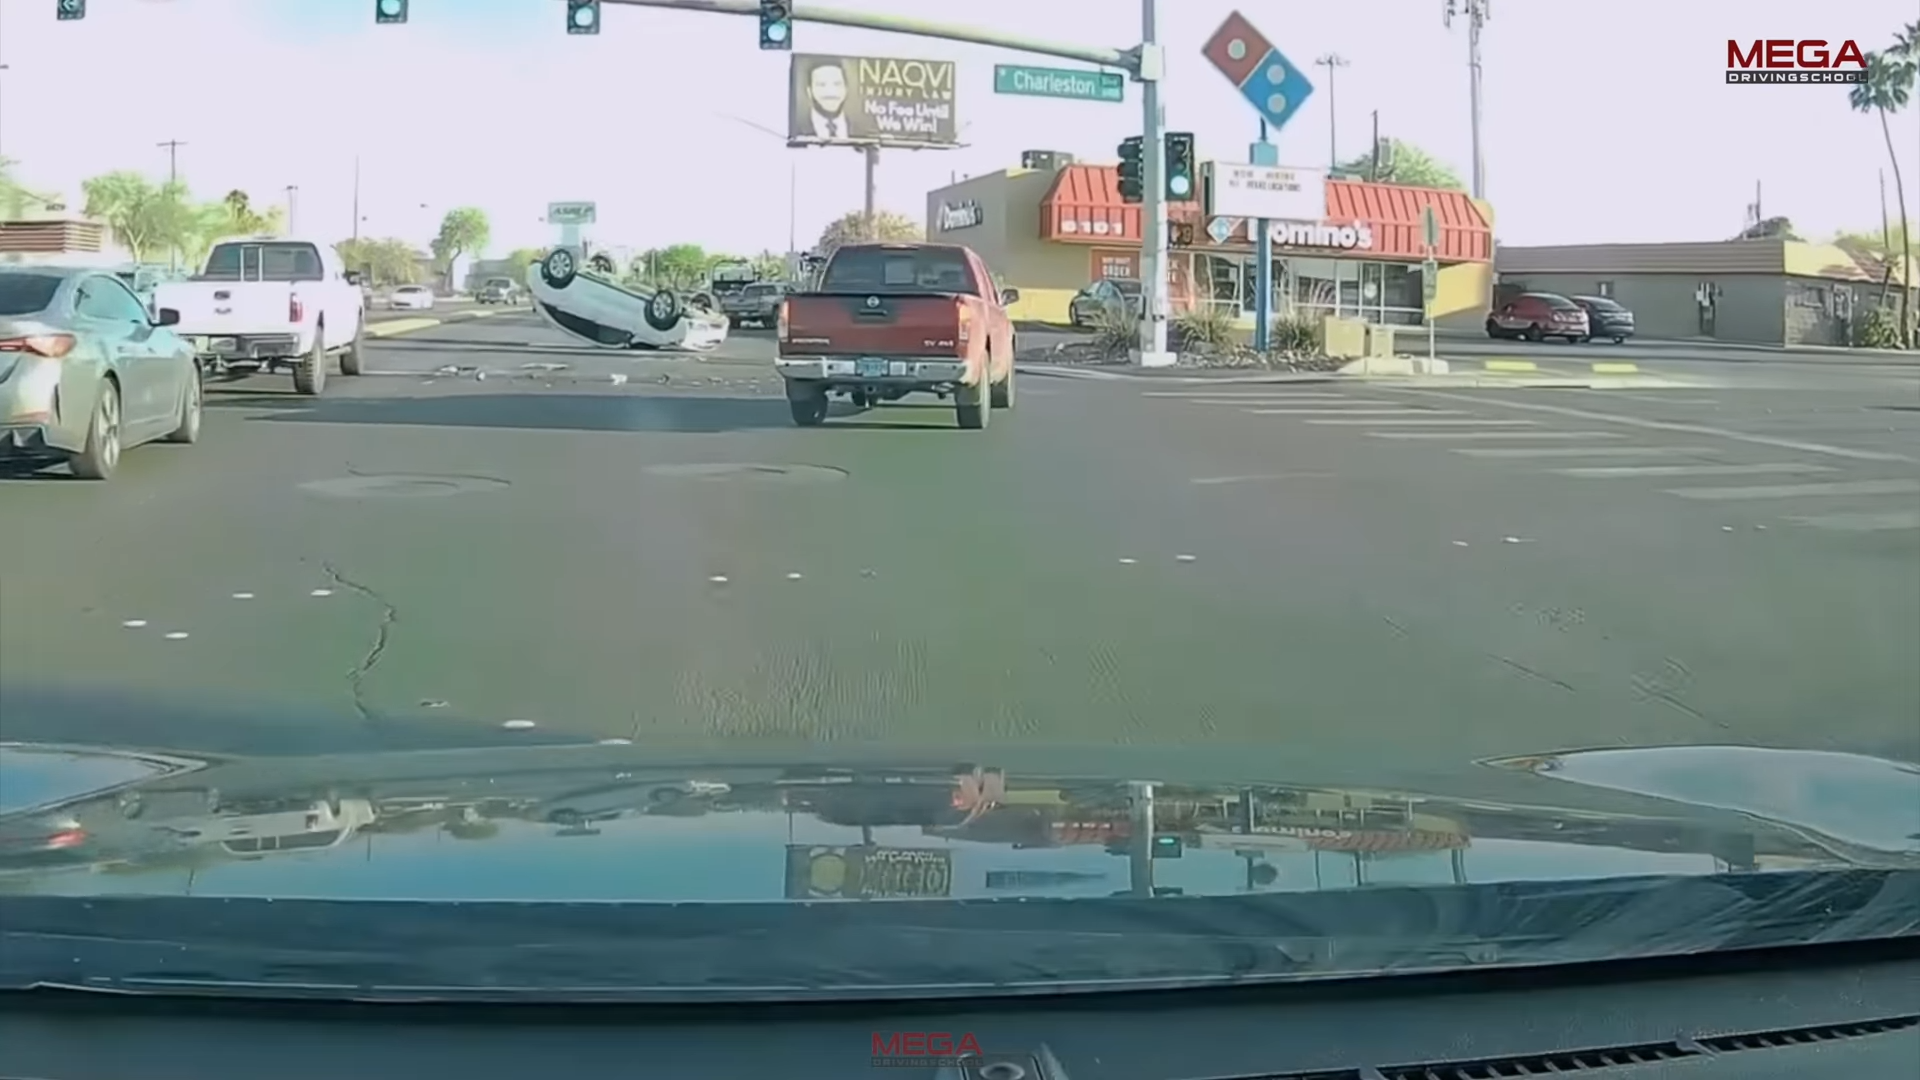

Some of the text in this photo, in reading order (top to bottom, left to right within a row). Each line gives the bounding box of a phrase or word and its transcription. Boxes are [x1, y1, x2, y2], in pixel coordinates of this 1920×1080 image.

[859, 59, 953, 89] NAQVI
[1014, 71, 1096, 95] Charleston
[865, 99, 949, 119] No Fee Until
[876, 115, 901, 131] We
